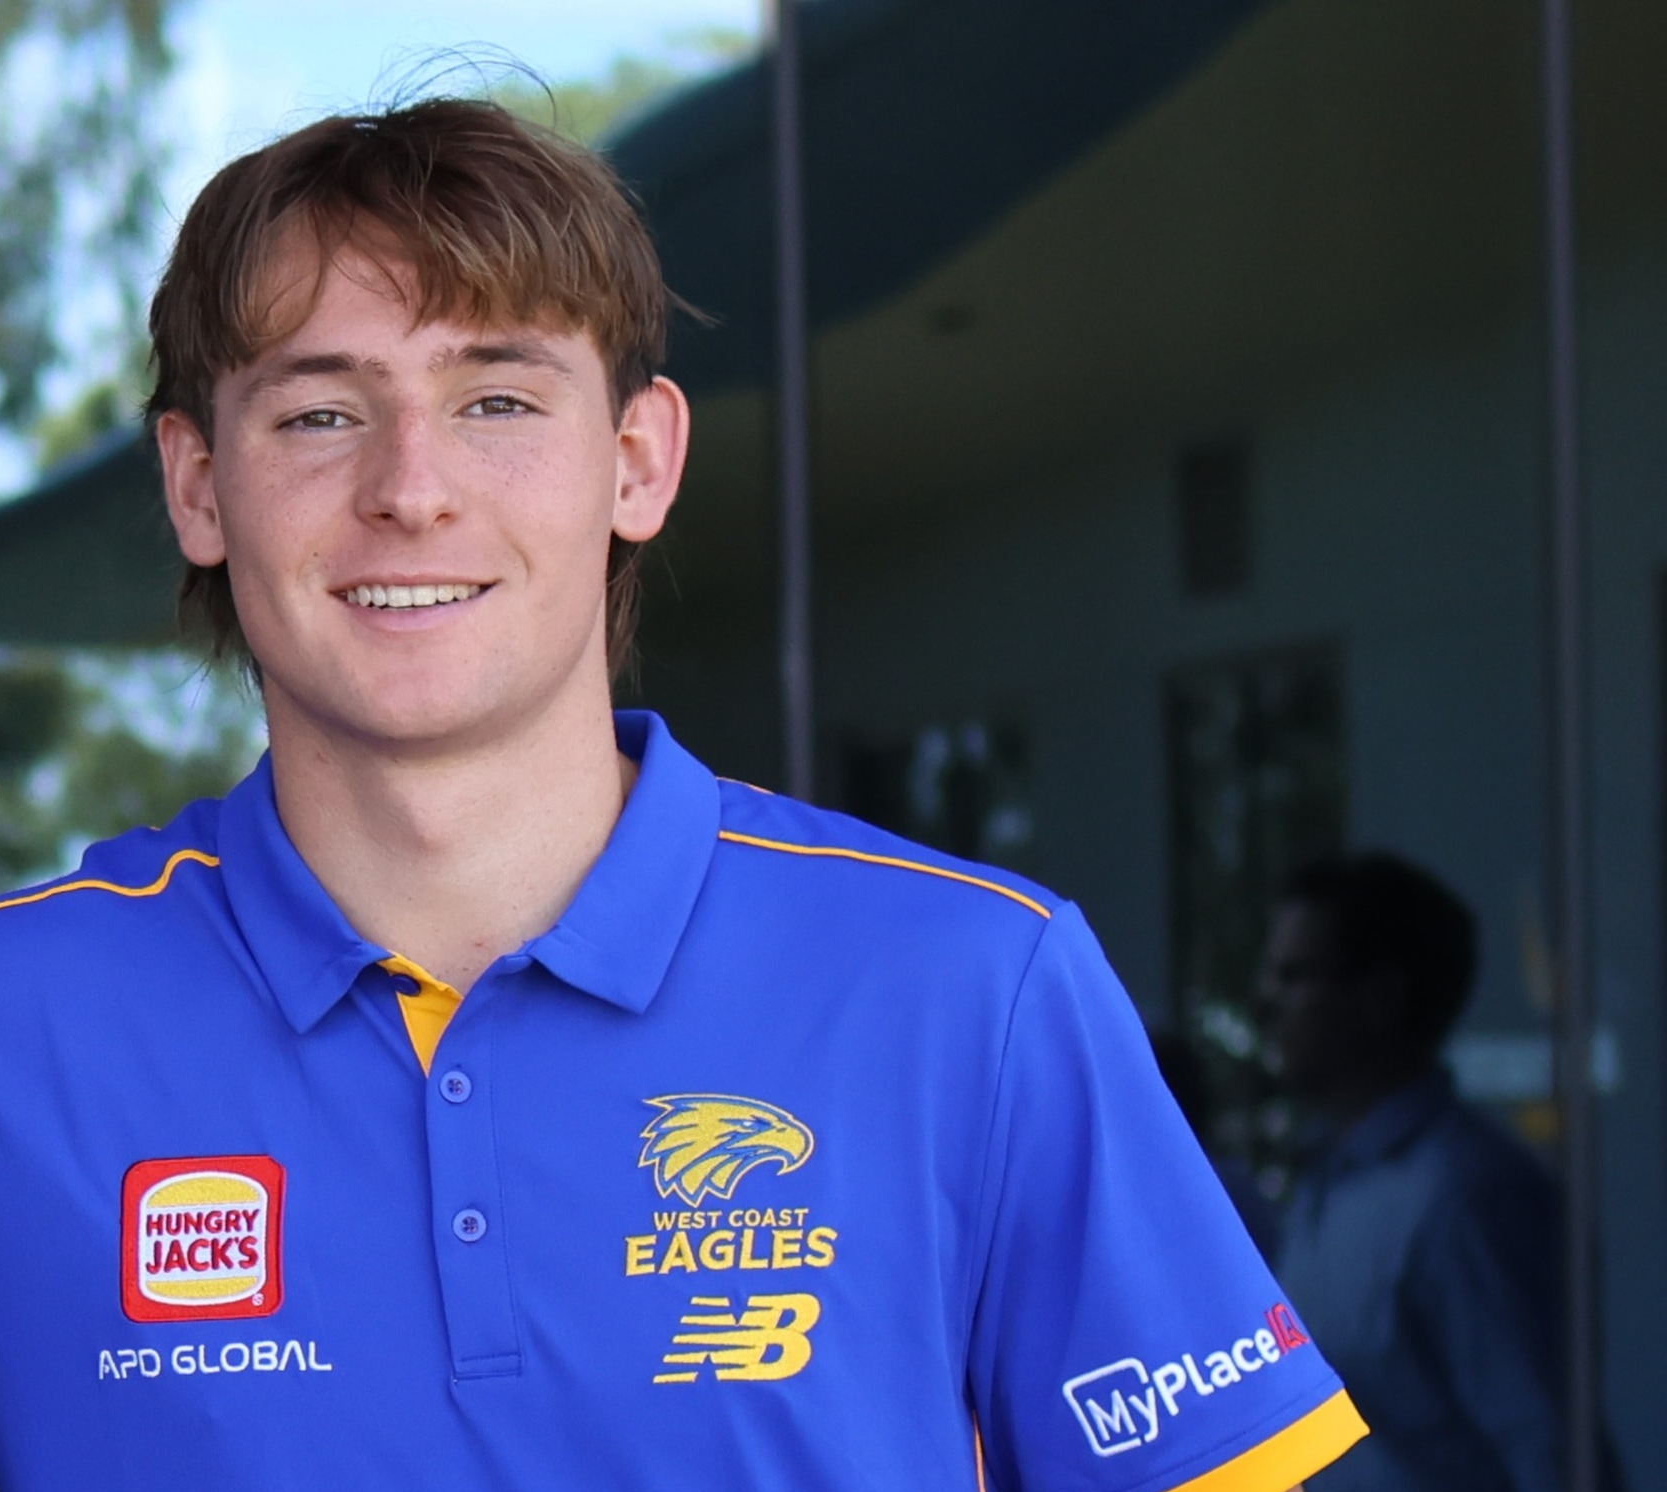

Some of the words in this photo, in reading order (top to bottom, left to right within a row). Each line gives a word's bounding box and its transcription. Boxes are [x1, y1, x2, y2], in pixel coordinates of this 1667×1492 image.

[145, 1208, 260, 1237] HUNGRY
[653, 1210, 722, 1231] WEST
[728, 1208, 809, 1228] COAST
[145, 1235, 259, 1275] JACK'S
[625, 1226, 838, 1277] EAGLES
[99, 1348, 161, 1380] APD
[172, 1340, 332, 1375] GLOBAL
